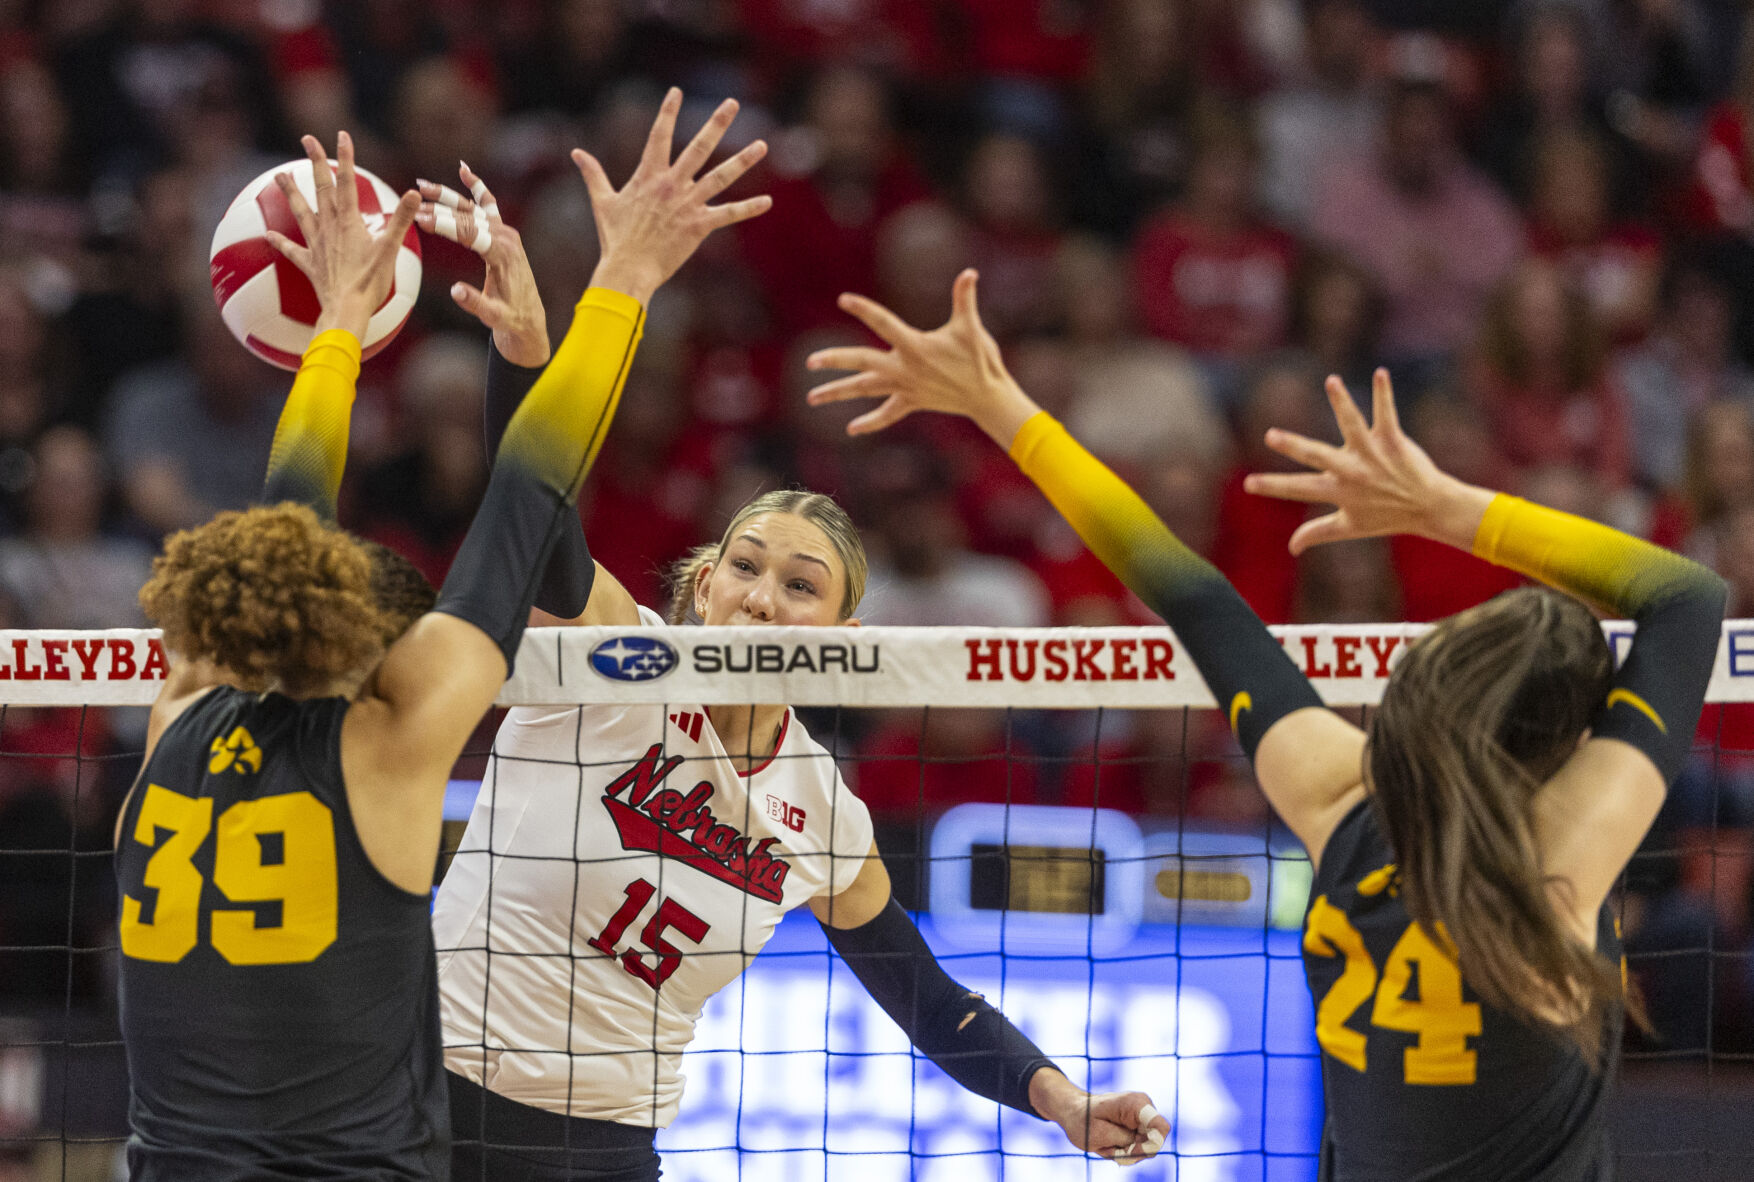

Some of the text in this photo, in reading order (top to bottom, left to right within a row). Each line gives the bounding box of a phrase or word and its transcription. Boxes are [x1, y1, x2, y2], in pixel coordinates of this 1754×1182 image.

[692, 644, 880, 673] SUBARU
[964, 638, 1176, 682] HUSKER
[119, 783, 339, 966] 39
[601, 743, 791, 905] Nebraska
[588, 877, 711, 990] 15
[1303, 893, 1483, 1086] 24
